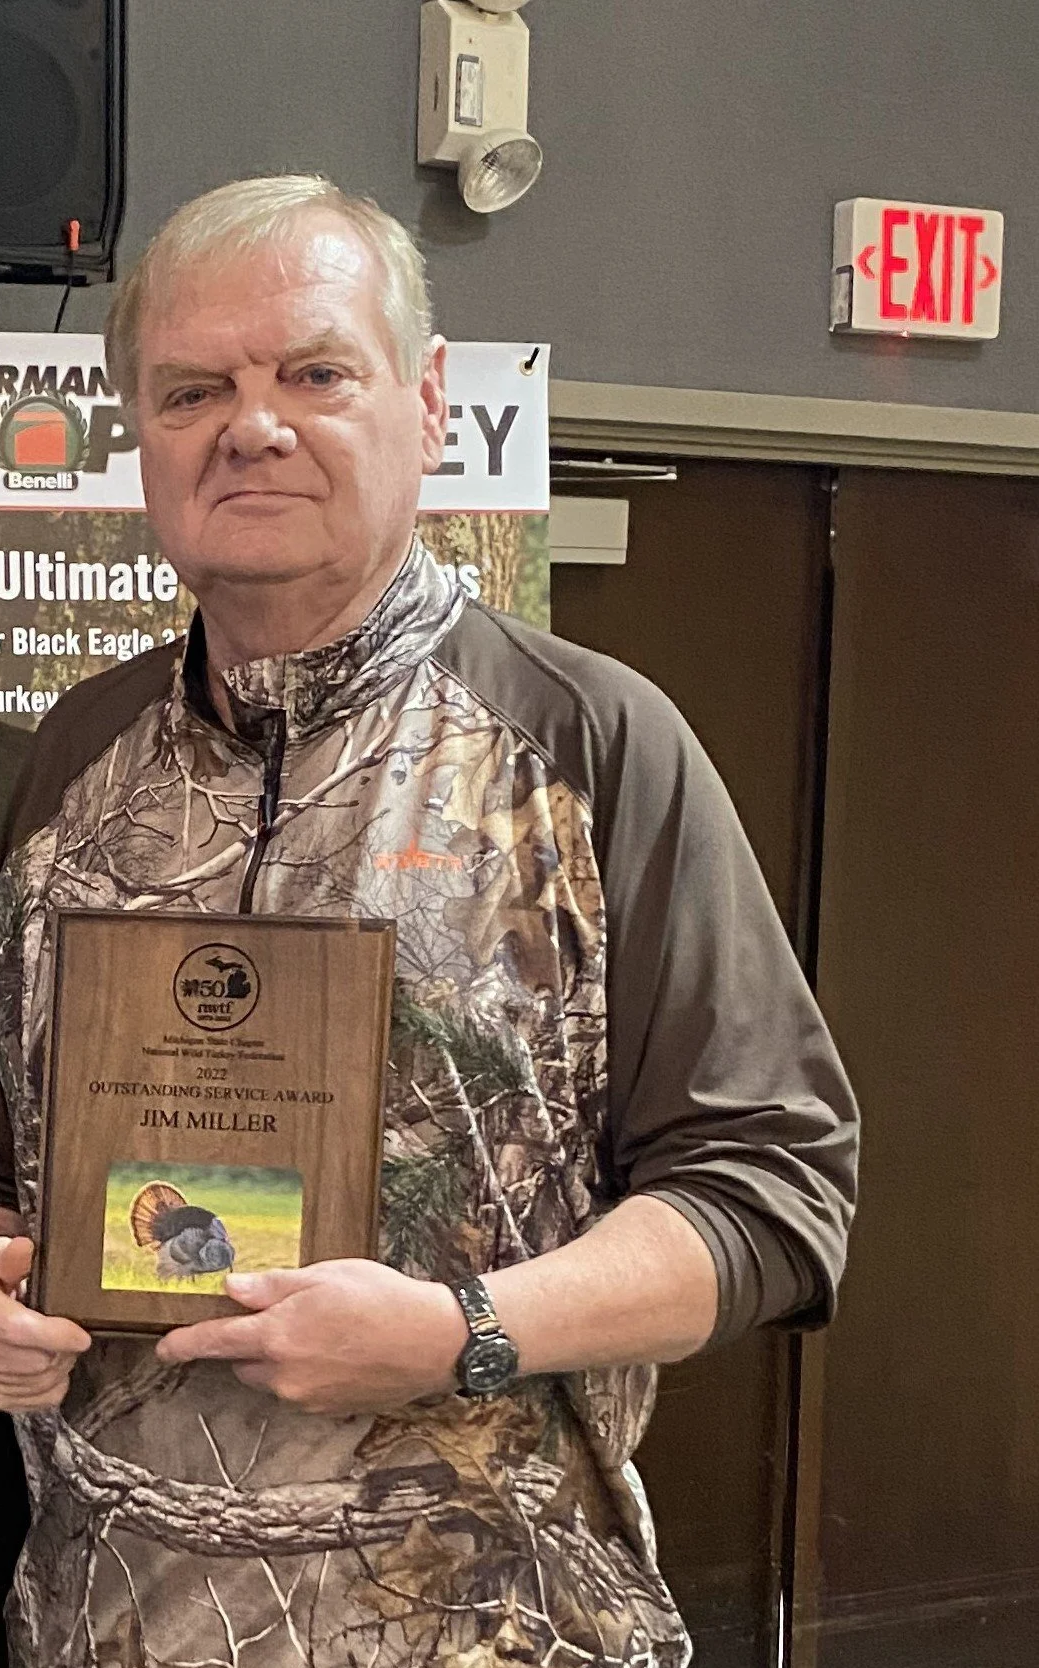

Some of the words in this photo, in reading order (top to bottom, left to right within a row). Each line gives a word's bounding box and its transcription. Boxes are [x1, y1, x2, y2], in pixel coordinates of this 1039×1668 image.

[880, 208, 985, 326] EXIT
[8, 472, 73, 489] Benelli
[12, 627, 82, 657] Black
[88, 628, 155, 662] Eagle
[196, 1067, 228, 1080] 2022
[89, 1080, 200, 1098] OUTSTANDING
[204, 1086, 269, 1101] SERVICE
[273, 1089, 335, 1104] AWARD
[140, 1108, 180, 1128] JIM
[187, 1112, 278, 1133] MILLER
